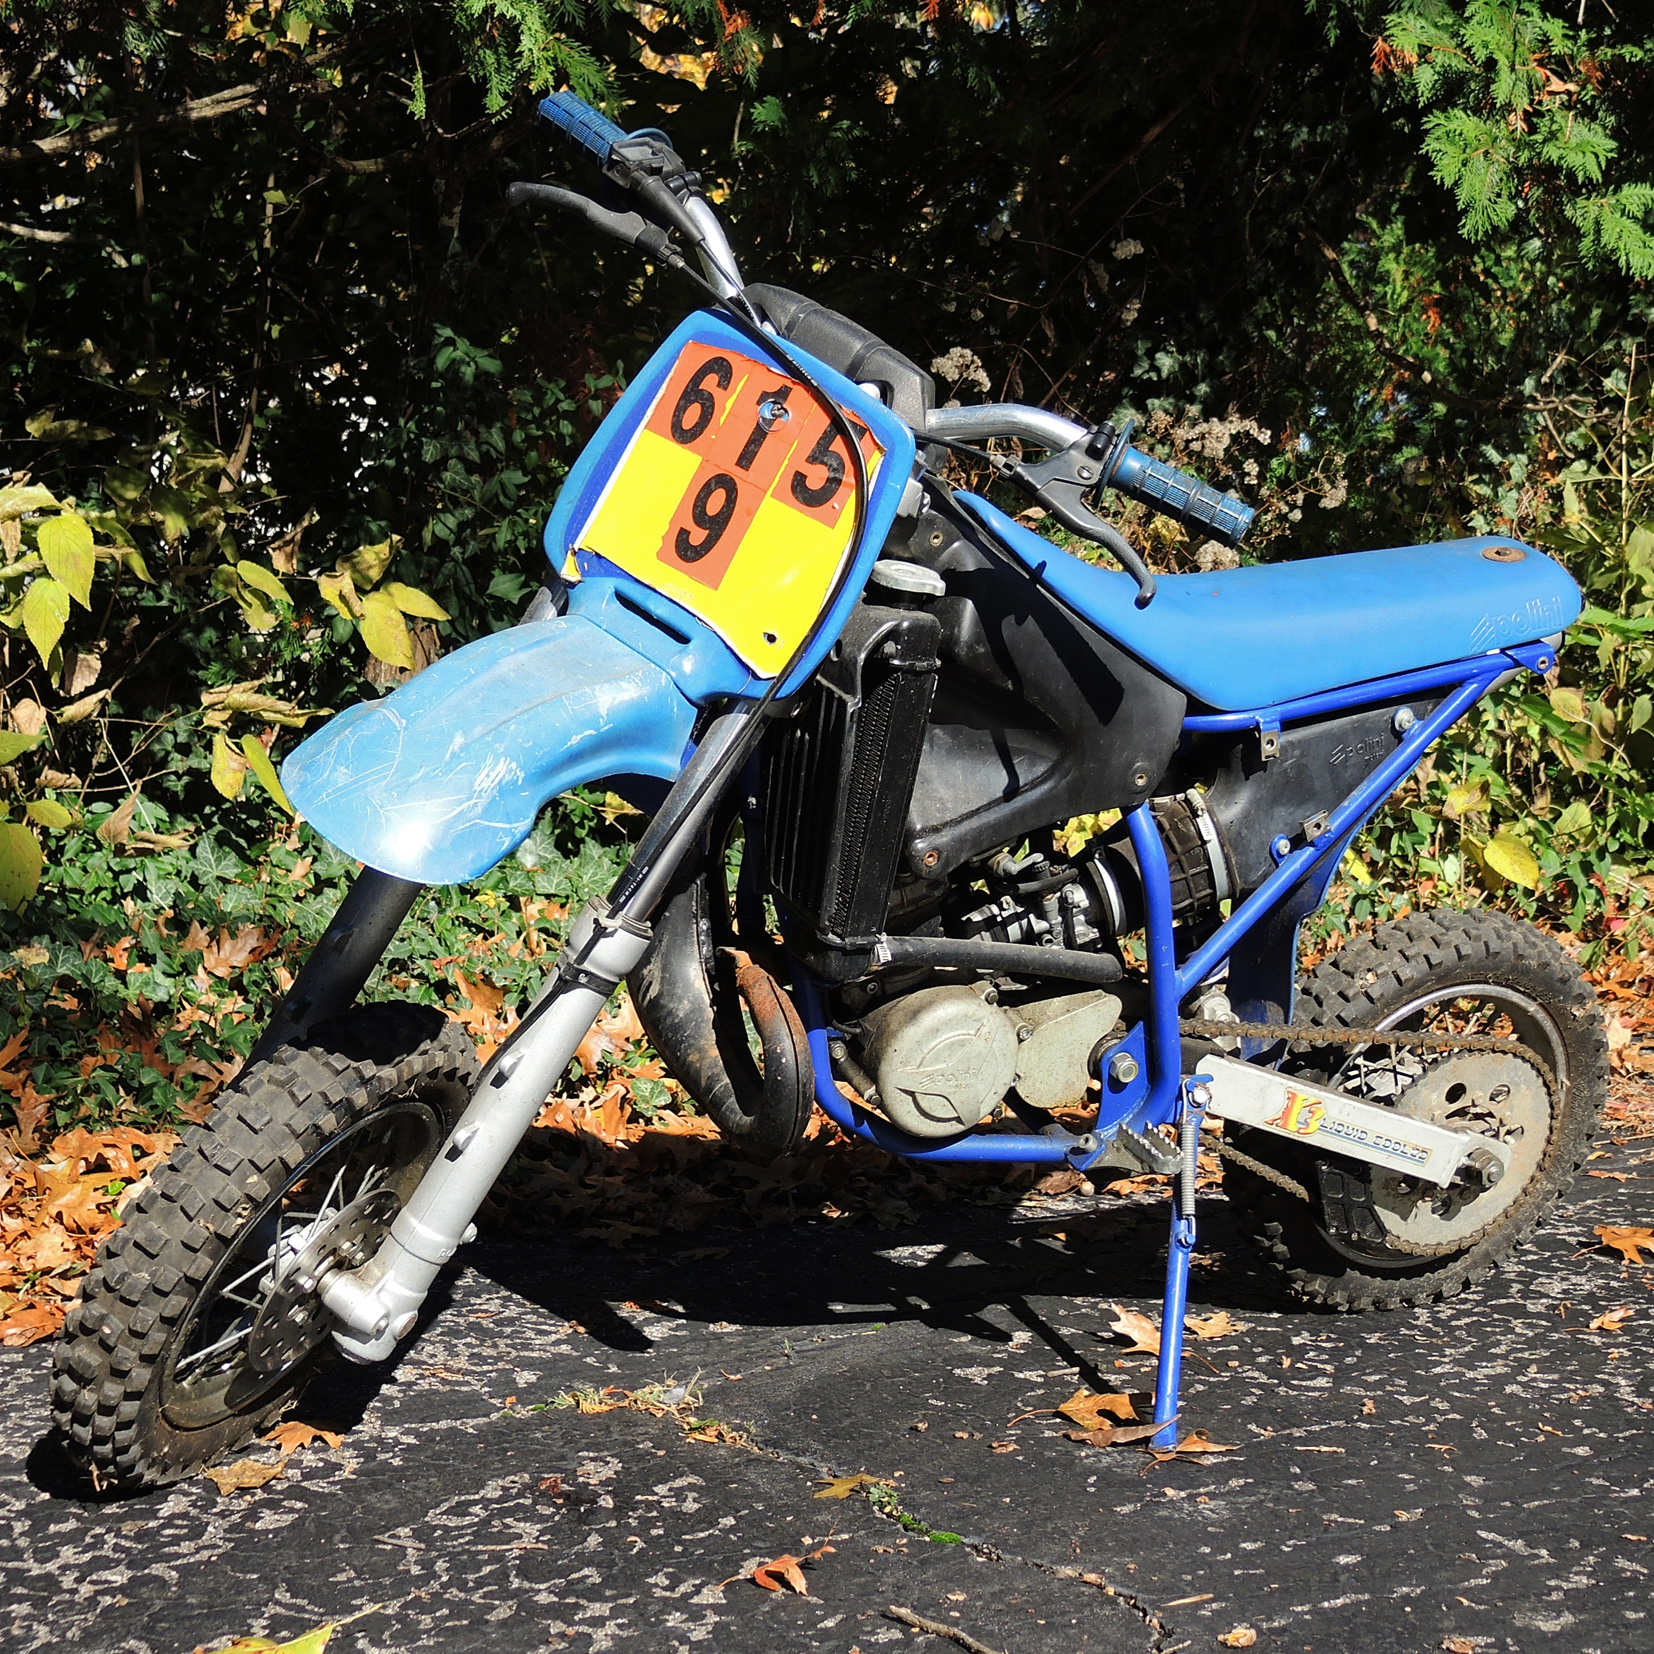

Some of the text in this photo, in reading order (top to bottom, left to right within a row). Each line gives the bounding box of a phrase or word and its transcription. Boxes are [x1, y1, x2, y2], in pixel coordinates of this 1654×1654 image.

[675, 473, 739, 563] 9
[1344, 732, 1386, 763] polini
[1319, 1117, 1429, 1161] LIQUID COOLED
